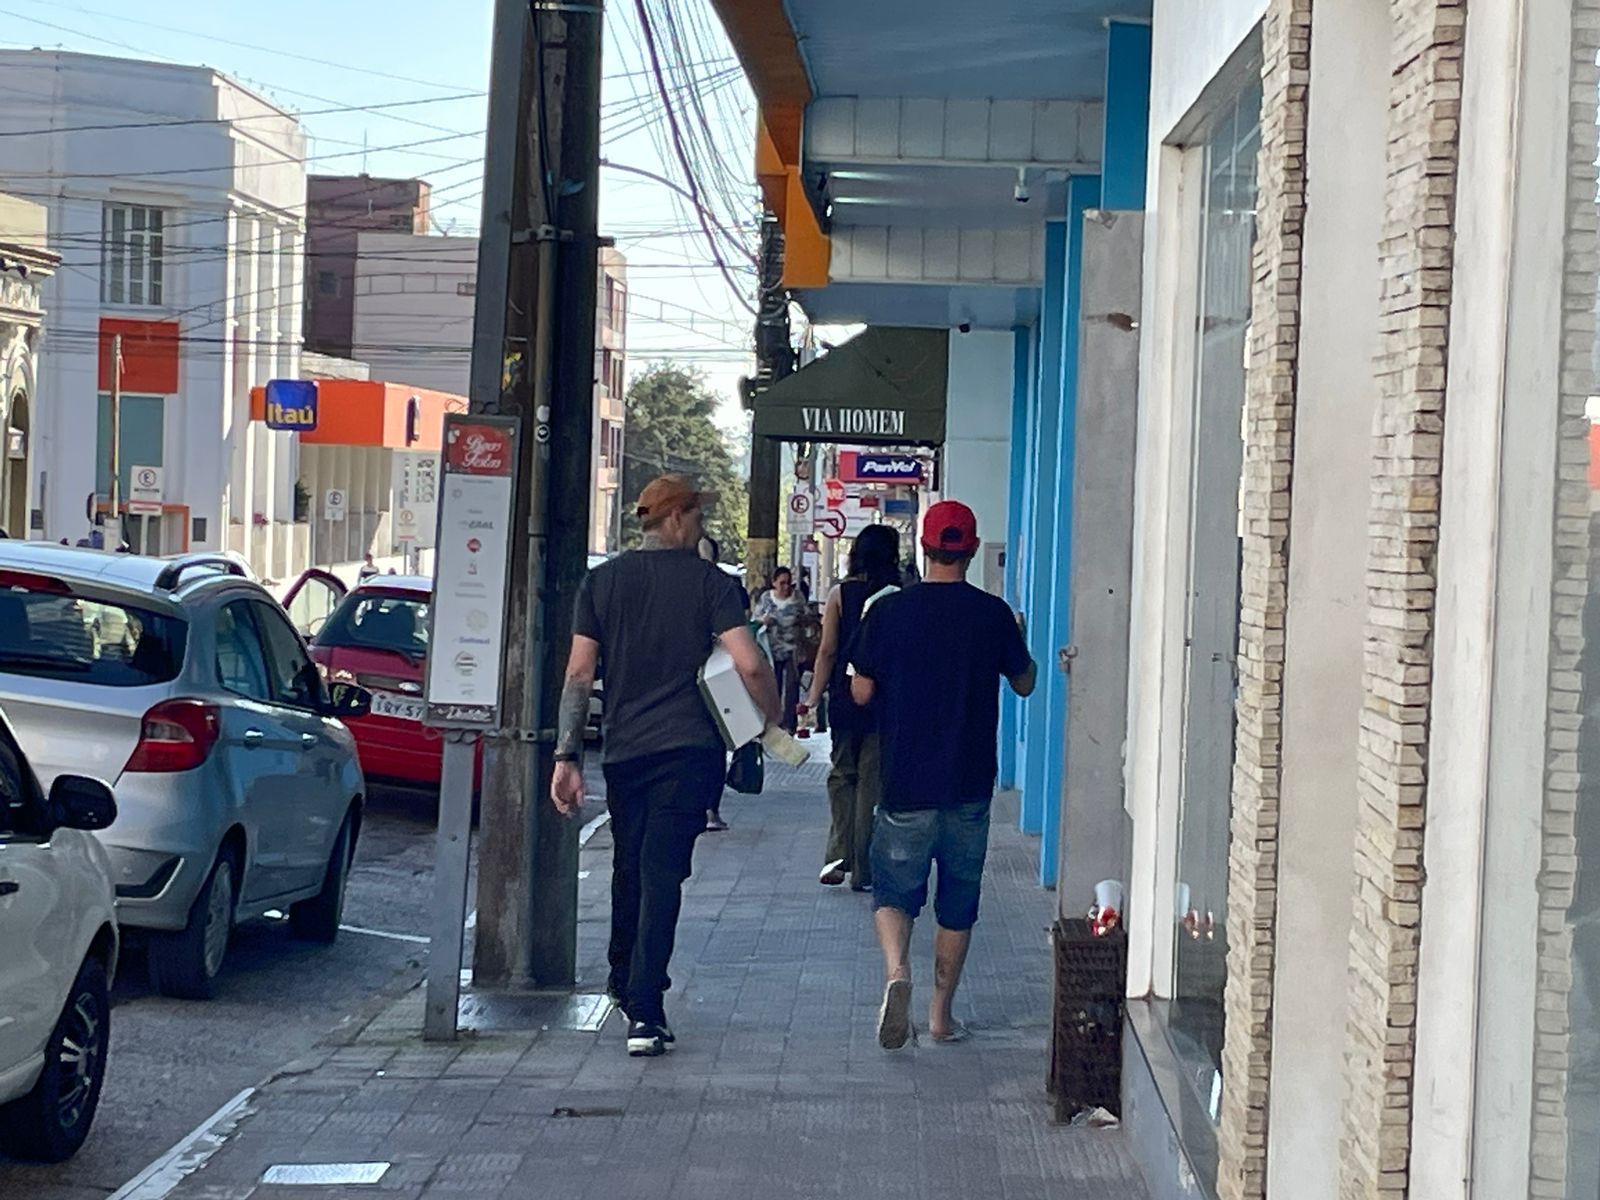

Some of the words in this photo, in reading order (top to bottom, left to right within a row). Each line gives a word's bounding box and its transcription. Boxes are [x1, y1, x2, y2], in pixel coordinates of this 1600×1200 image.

[267, 402, 313, 424] Itaú
[803, 408, 832, 432] VIA
[839, 409, 905, 435] HOMEM
